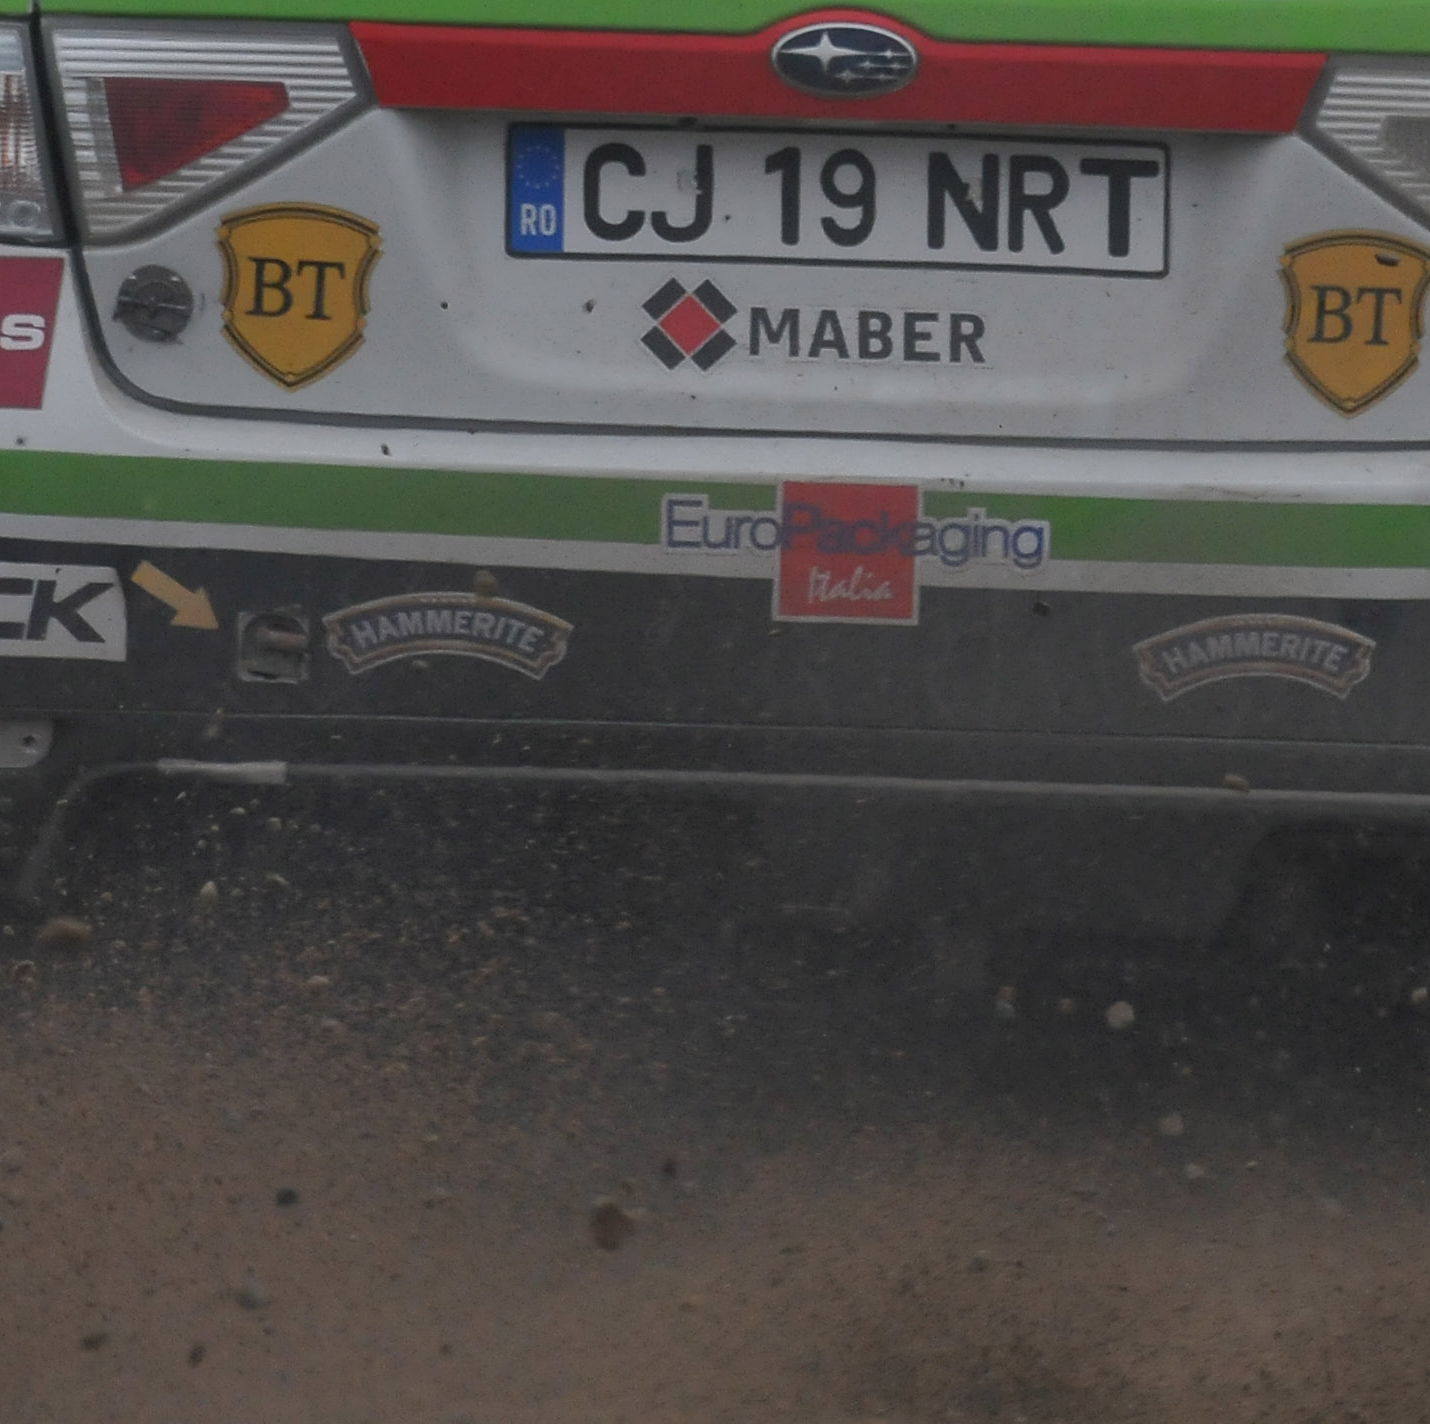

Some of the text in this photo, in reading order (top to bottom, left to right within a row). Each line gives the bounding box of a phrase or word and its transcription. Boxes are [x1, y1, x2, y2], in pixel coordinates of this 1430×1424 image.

[519, 203, 556, 237] RO
[583, 142, 1160, 258] CJ 19 NRT
[244, 256, 347, 322] BT
[1306, 283, 1403, 346] BT
[748, 306, 987, 364] MABER
[665, 498, 1045, 570] EuroPackaging
[807, 565, 897, 605] Italia
[350, 609, 546, 654] HAMMERITE
[1162, 631, 1350, 674] HAMMERITE
